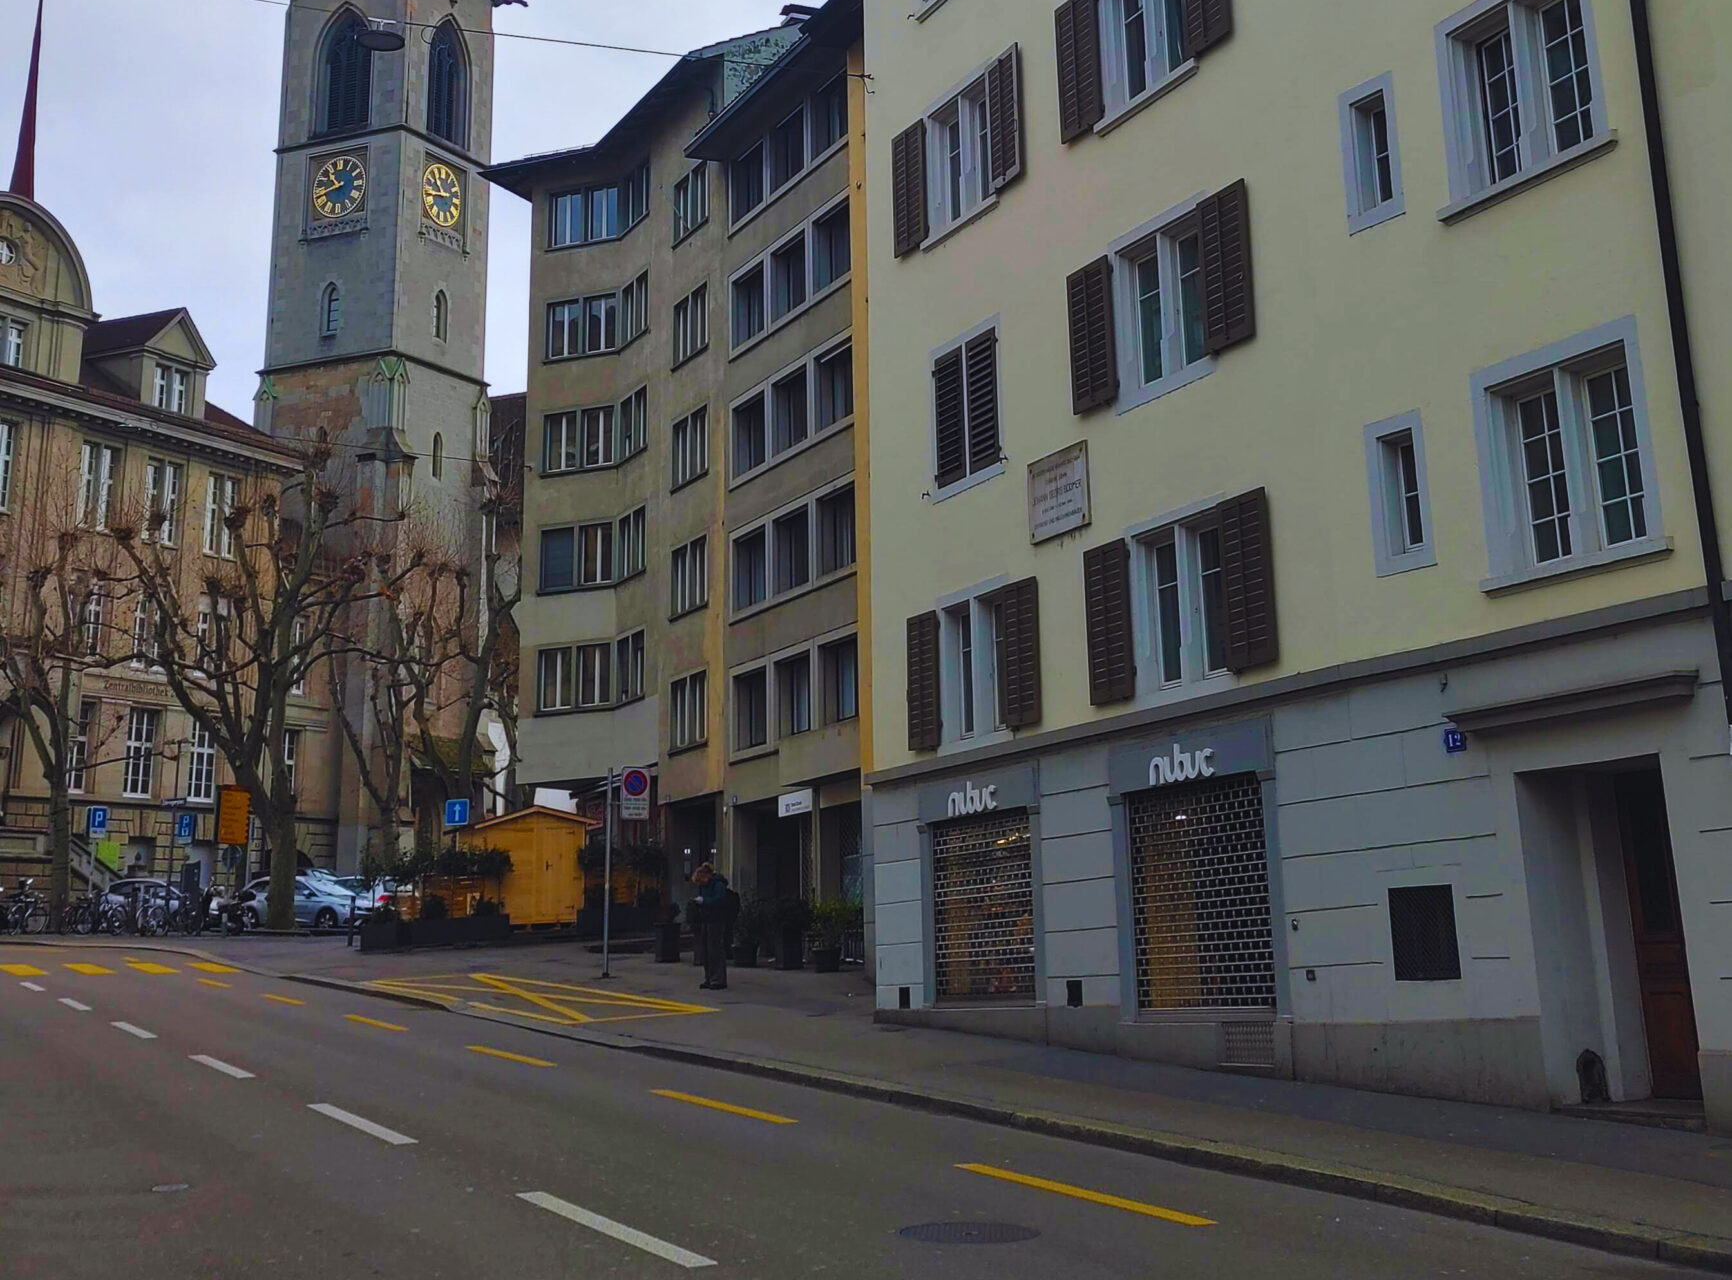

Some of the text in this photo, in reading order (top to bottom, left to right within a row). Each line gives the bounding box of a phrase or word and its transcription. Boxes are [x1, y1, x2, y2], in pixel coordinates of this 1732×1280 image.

[1448, 733, 1462, 747] 12
[1148, 743, 1216, 786] nubuc
[947, 780, 998, 817] nubuc
[95, 811, 103, 827] P
